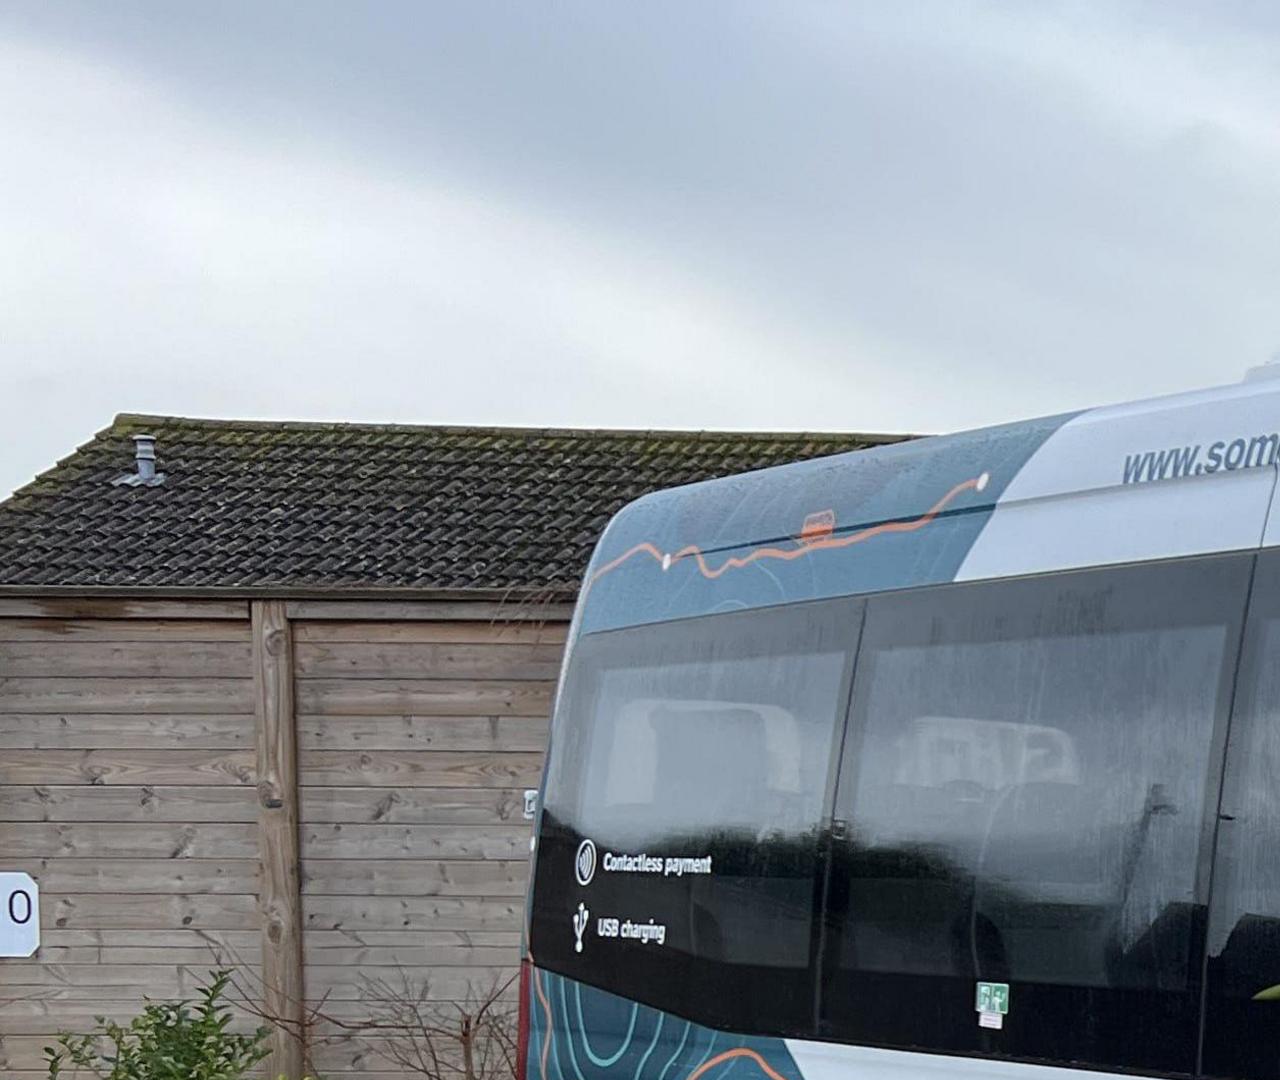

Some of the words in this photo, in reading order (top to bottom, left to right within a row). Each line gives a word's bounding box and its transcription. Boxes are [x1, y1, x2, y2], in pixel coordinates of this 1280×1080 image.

[603, 852, 663, 872] Contactless
[664, 855, 712, 877] payment
[598, 918, 619, 937] USB
[620, 918, 666, 945] charging
